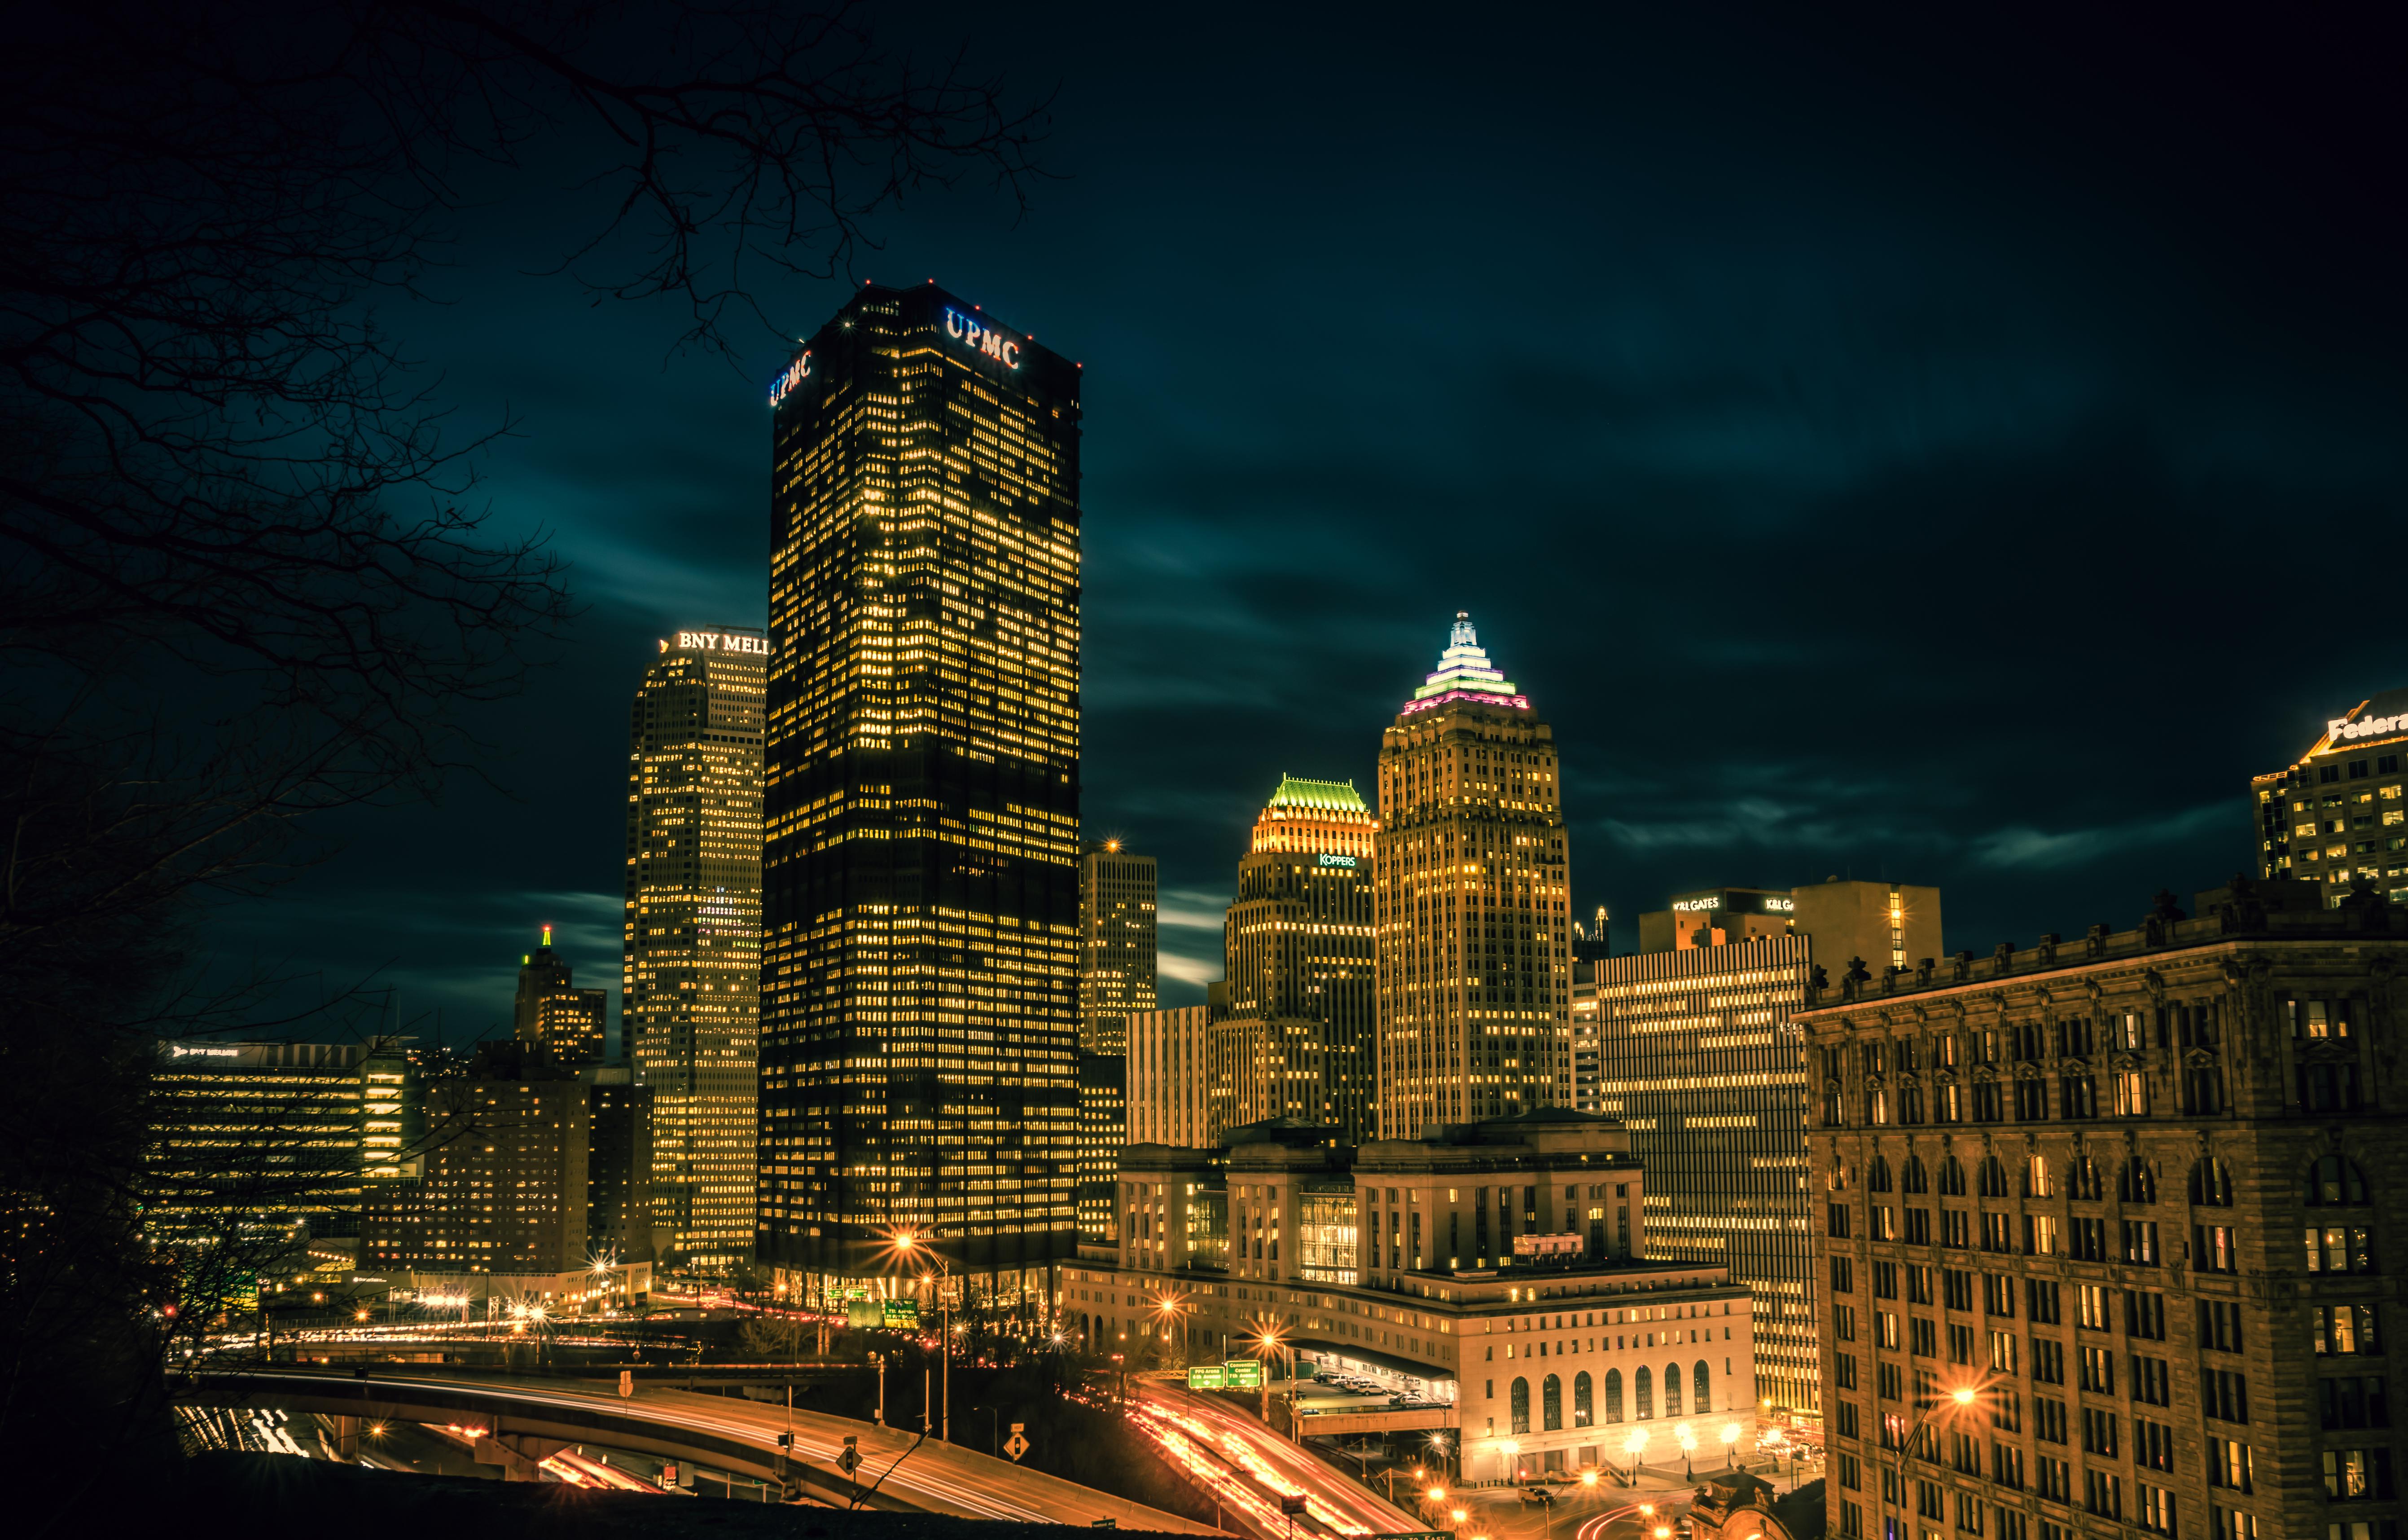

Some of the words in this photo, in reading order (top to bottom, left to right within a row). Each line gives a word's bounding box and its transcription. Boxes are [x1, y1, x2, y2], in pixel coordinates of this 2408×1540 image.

[947, 308, 1019, 370] UPMC
[770, 350, 811, 406] UPMC
[679, 632, 719, 649] BNY
[1320, 853, 1355, 866] KOPPERS
[1690, 897, 1719, 911] GATES
[1766, 899, 1783, 910] K&L
